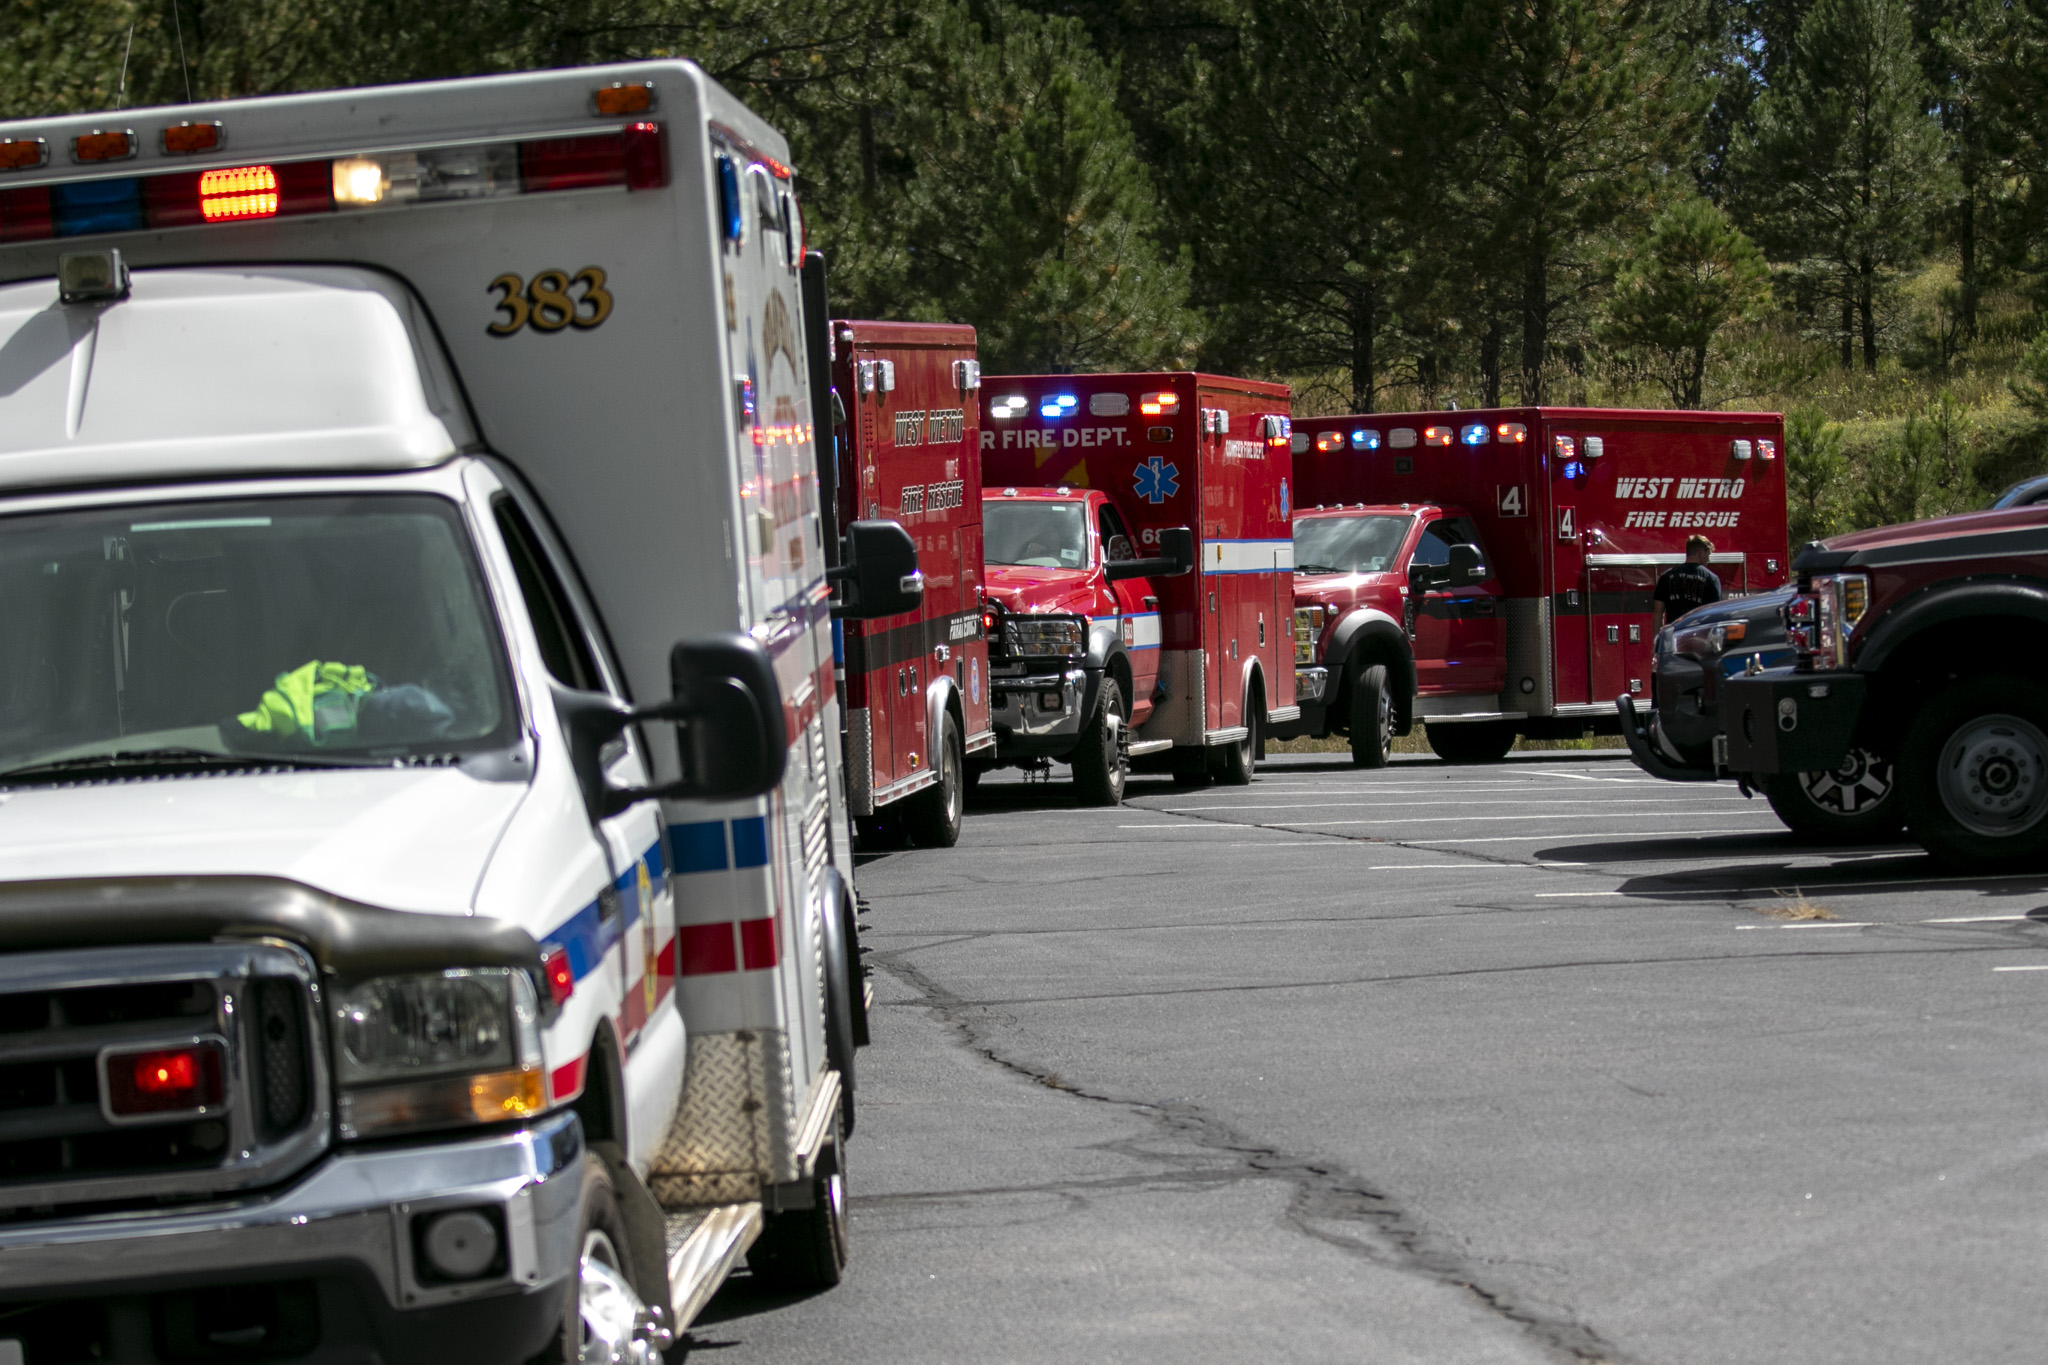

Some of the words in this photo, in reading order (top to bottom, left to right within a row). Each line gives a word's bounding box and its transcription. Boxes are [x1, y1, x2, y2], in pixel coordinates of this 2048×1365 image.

[486, 265, 615, 339] 383
[895, 410, 925, 447] WEST
[928, 408, 964, 444] METRO
[1002, 429, 1056, 449] FIRE
[1063, 427, 1132, 448] DEPT.
[900, 485, 925, 515] FIRE
[926, 480, 964, 511] RESCUE
[1502, 486, 1521, 515] 4
[1615, 478, 1674, 499] WEST
[1676, 478, 1745, 499] METRO
[1561, 508, 1573, 537] 4
[1624, 512, 1667, 528] FIRE
[1669, 512, 1740, 528] RESCUE
[1141, 528, 1166, 545] 68
